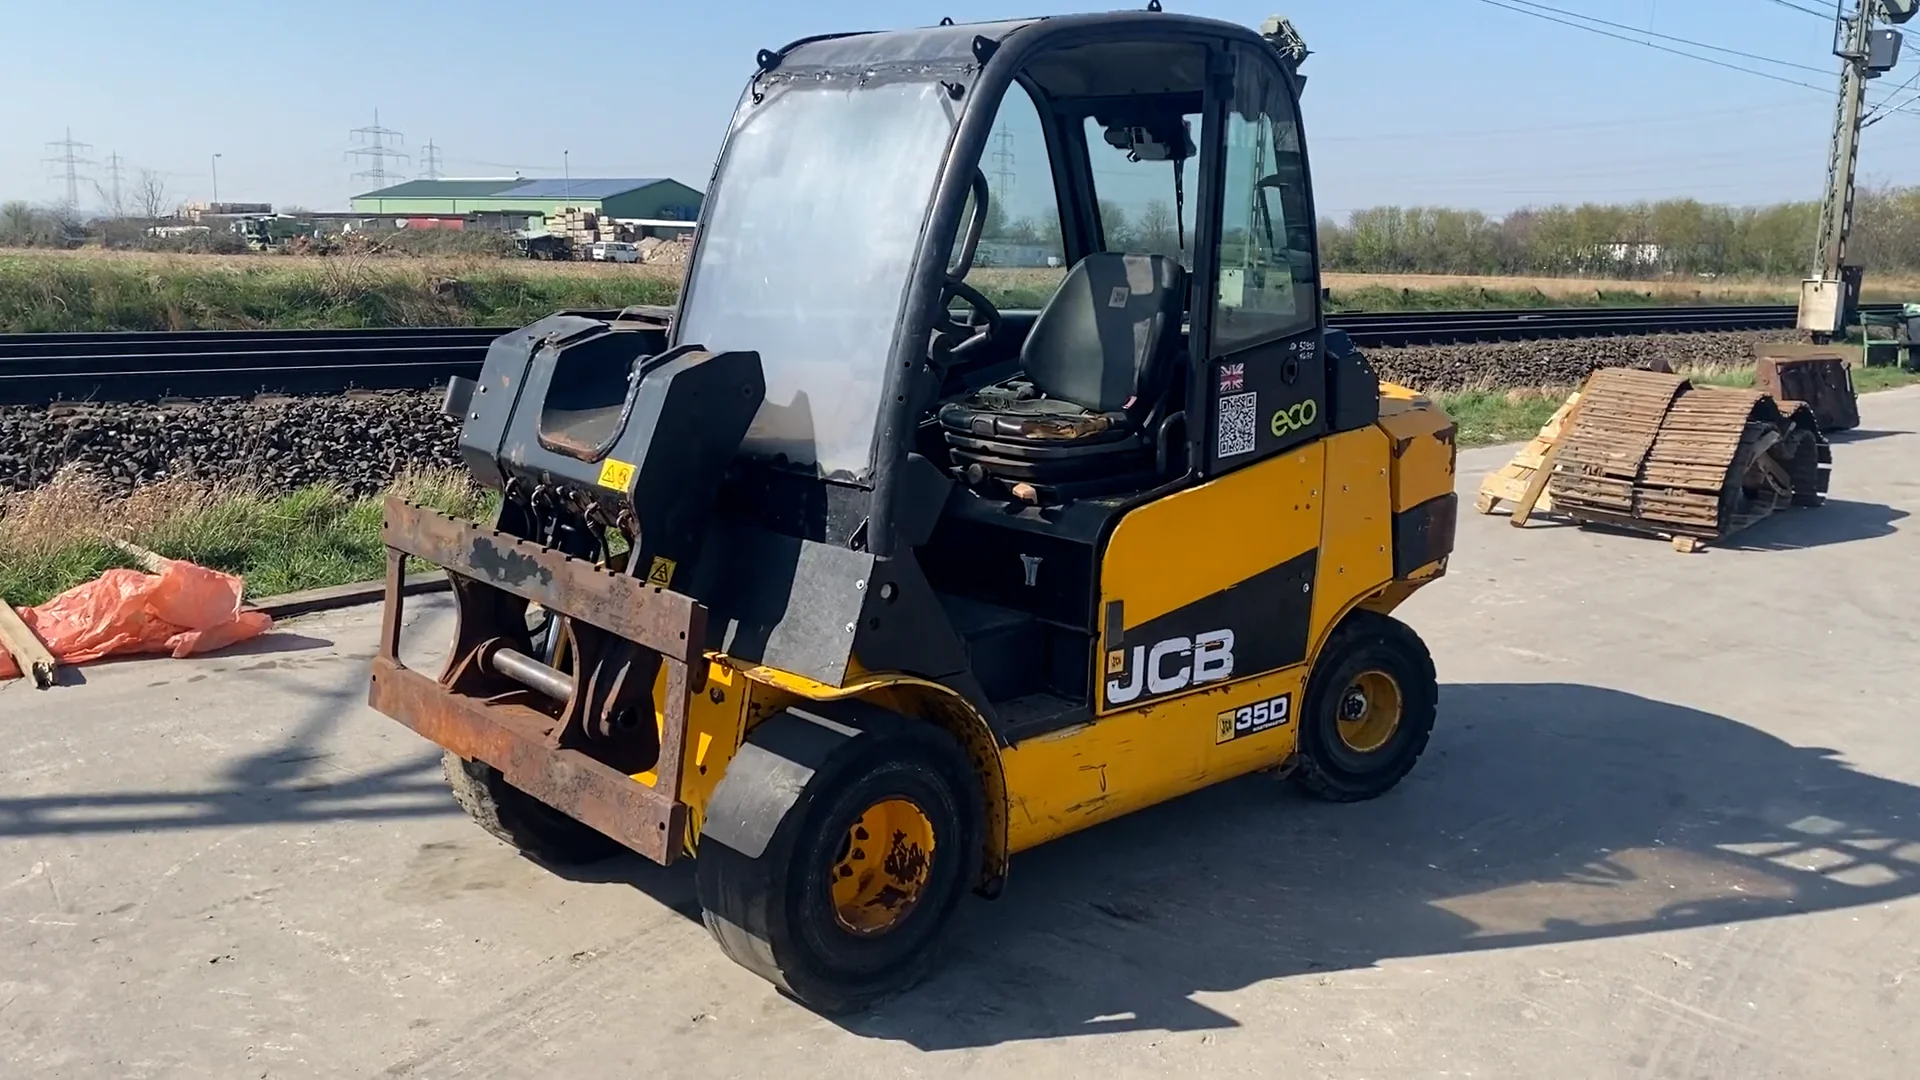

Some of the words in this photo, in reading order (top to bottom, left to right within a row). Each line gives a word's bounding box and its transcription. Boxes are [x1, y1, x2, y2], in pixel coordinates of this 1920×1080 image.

[1271, 399, 1317, 437] eco
[1107, 628, 1235, 704] JCB
[1236, 697, 1288, 731] 35D
